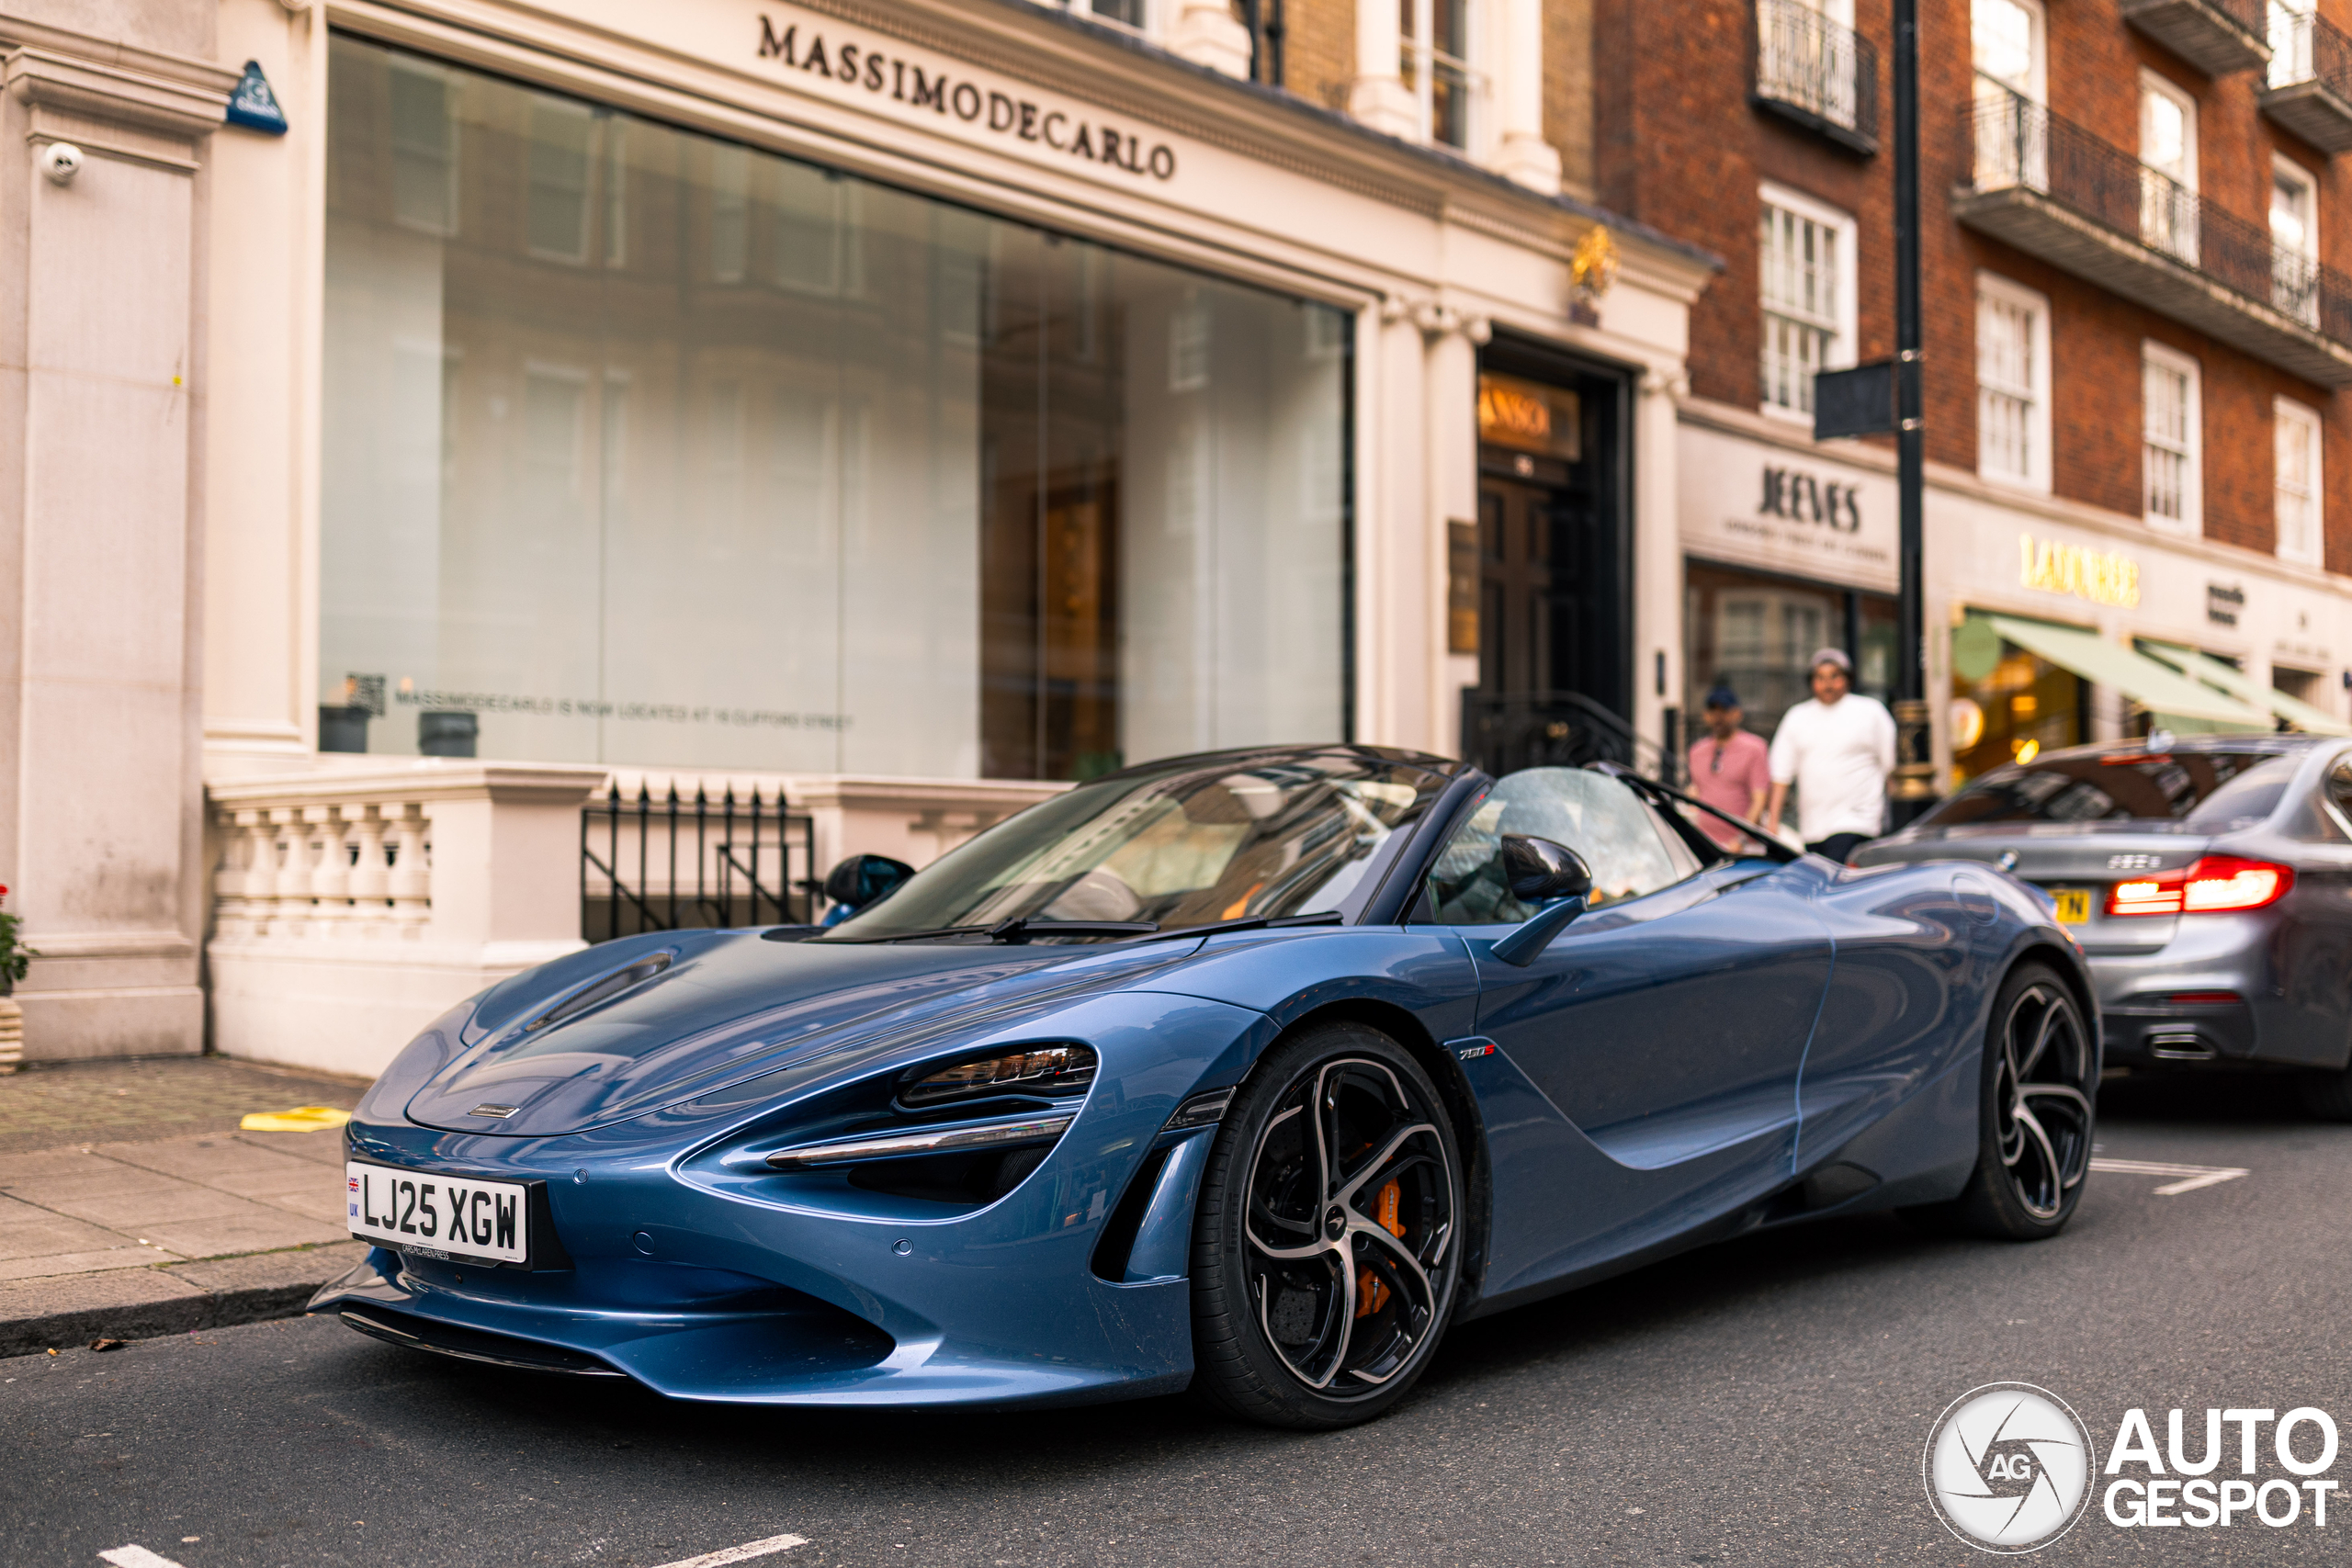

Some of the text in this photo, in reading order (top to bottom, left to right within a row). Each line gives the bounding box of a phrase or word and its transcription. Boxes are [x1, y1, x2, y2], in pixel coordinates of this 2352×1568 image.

[757, 15, 1175, 180] MASSIMODECARLO
[1758, 464, 1860, 533] JEEVES
[1459, 1044, 1495, 1060] 750S
[349, 1202, 358, 1217] UK
[364, 1174, 516, 1249] LJ25 XGW
